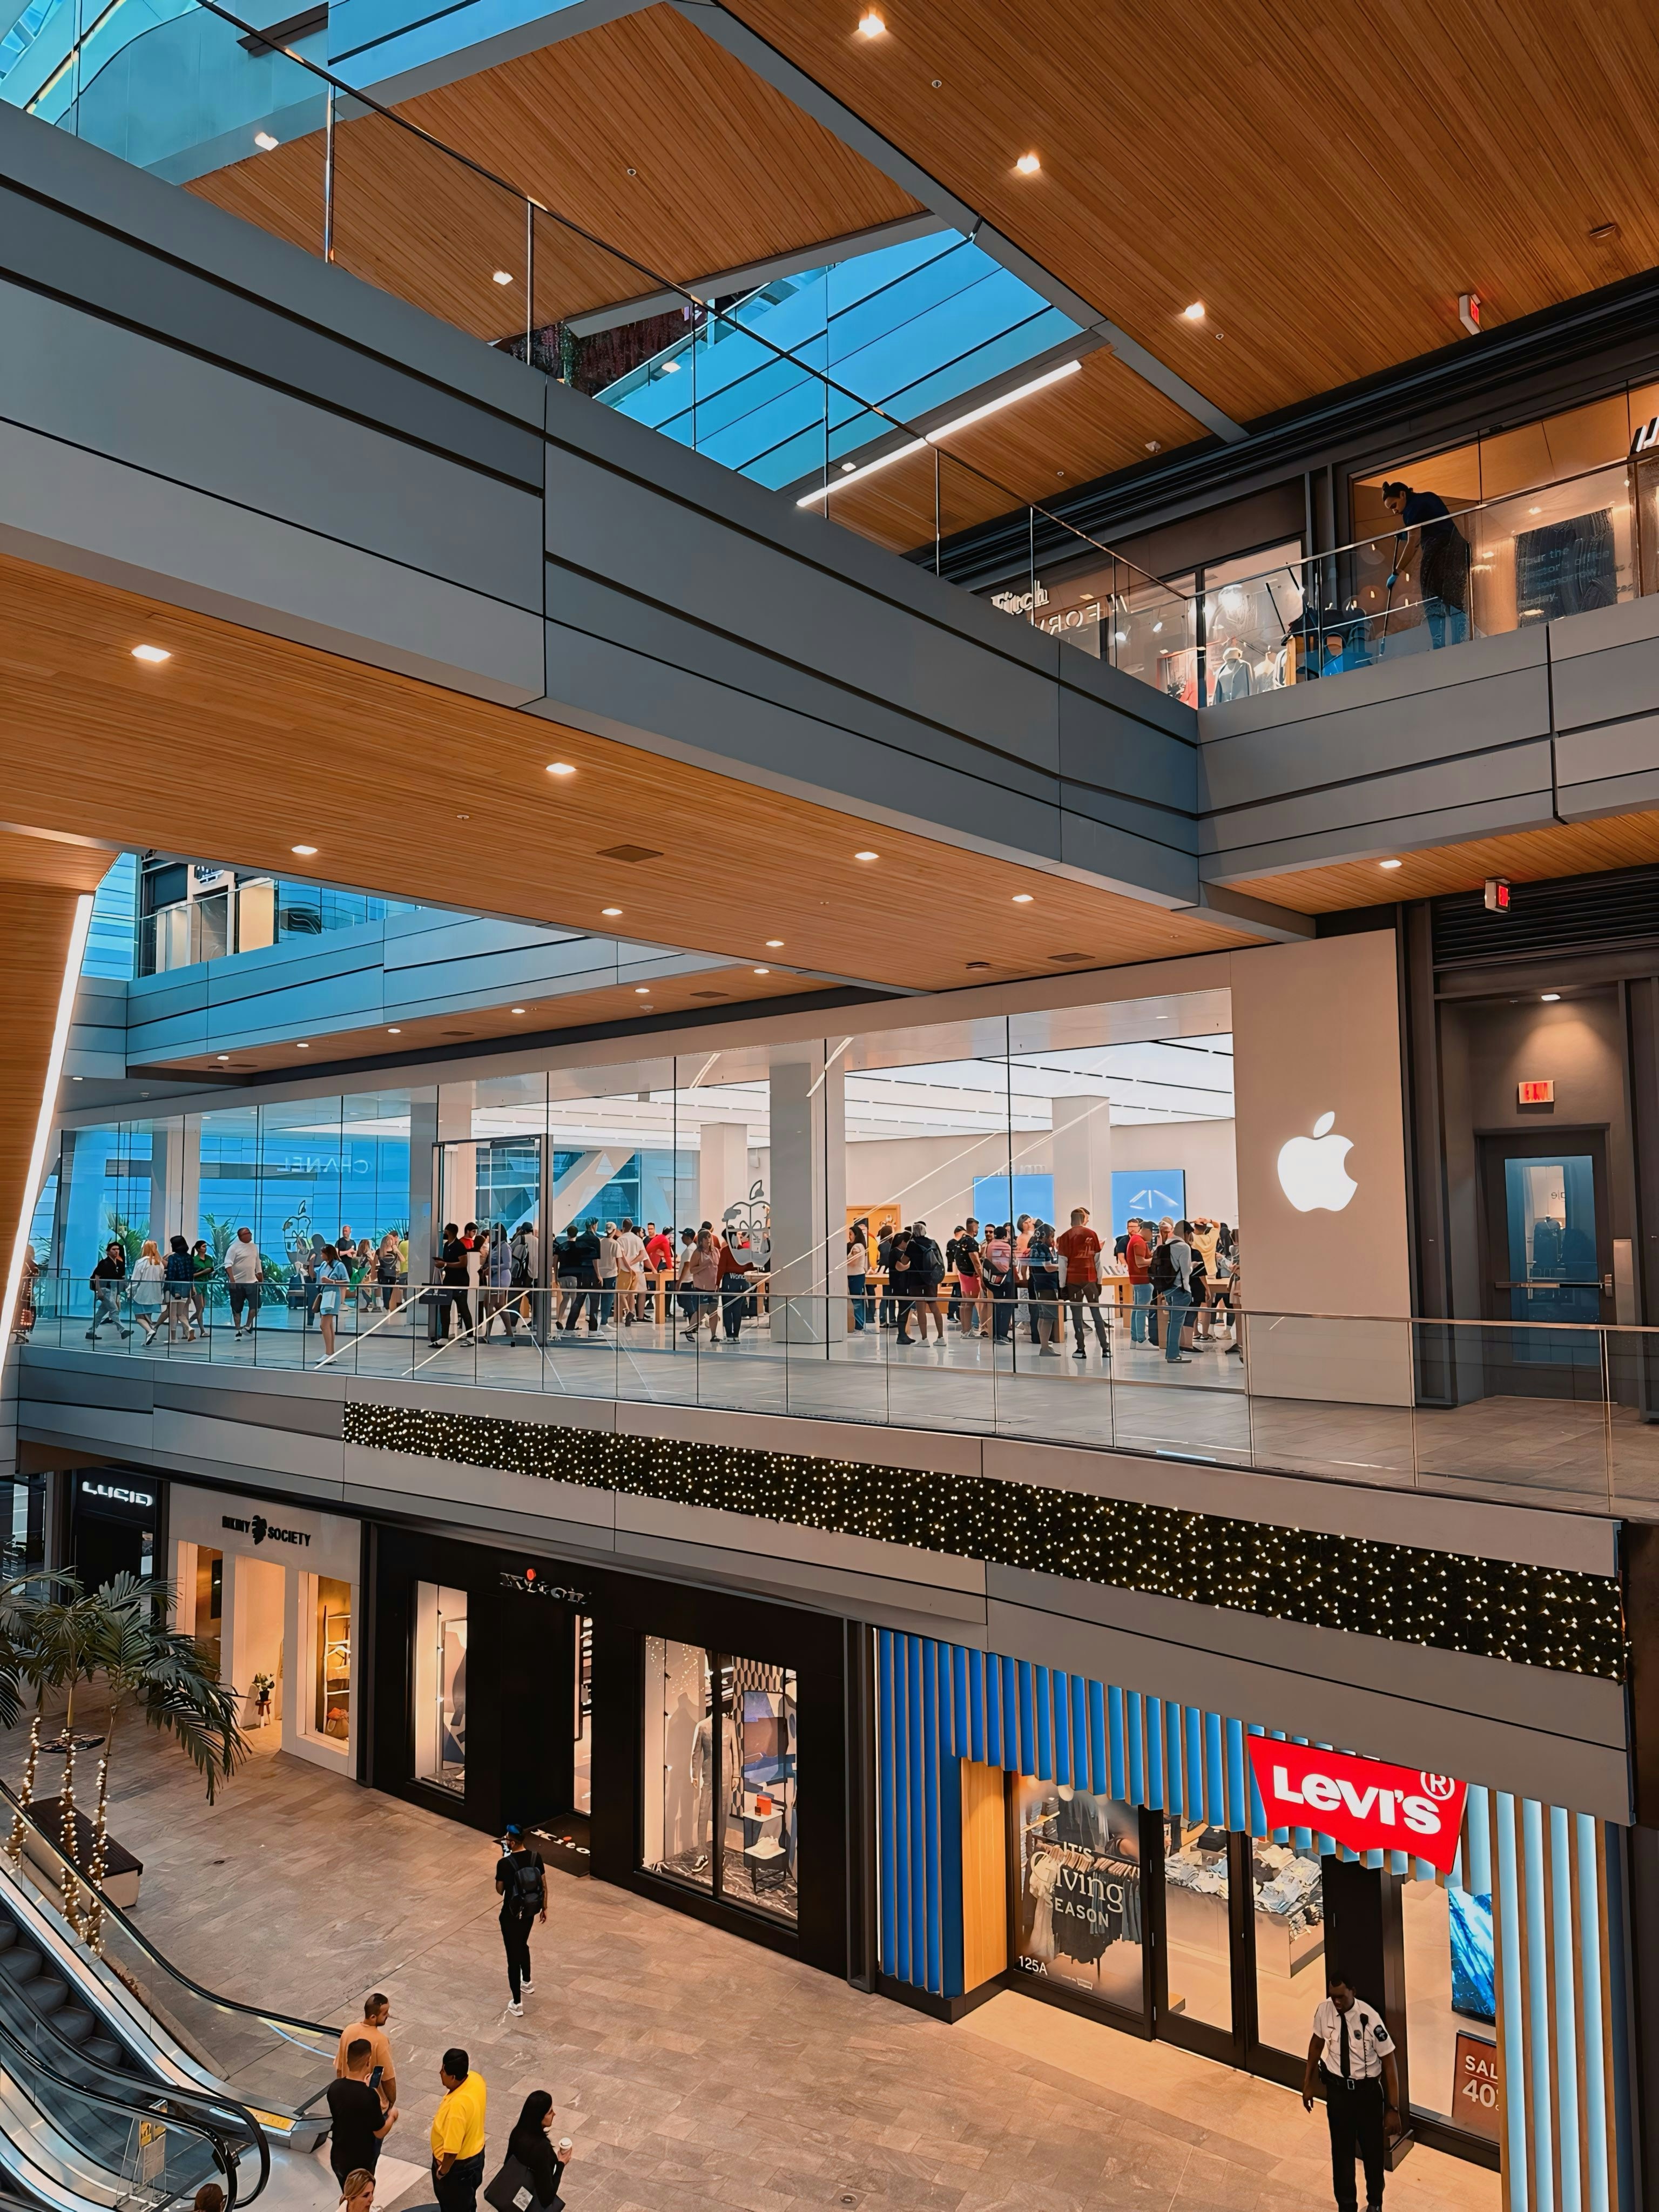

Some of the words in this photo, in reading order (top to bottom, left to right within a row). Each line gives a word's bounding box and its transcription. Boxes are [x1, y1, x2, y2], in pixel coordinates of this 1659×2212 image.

[82, 1481, 153, 1507] LUCID
[267, 1526, 312, 1547] SOCIETY
[530, 1829, 591, 1856] Kito
[1063, 1841, 1095, 1863] IT'S
[1045, 1896, 1109, 1928] SEASON
[1019, 1955, 1048, 1976] 125A
[1465, 2055, 1499, 2080] SAL
[1462, 2079, 1499, 2108] 40
